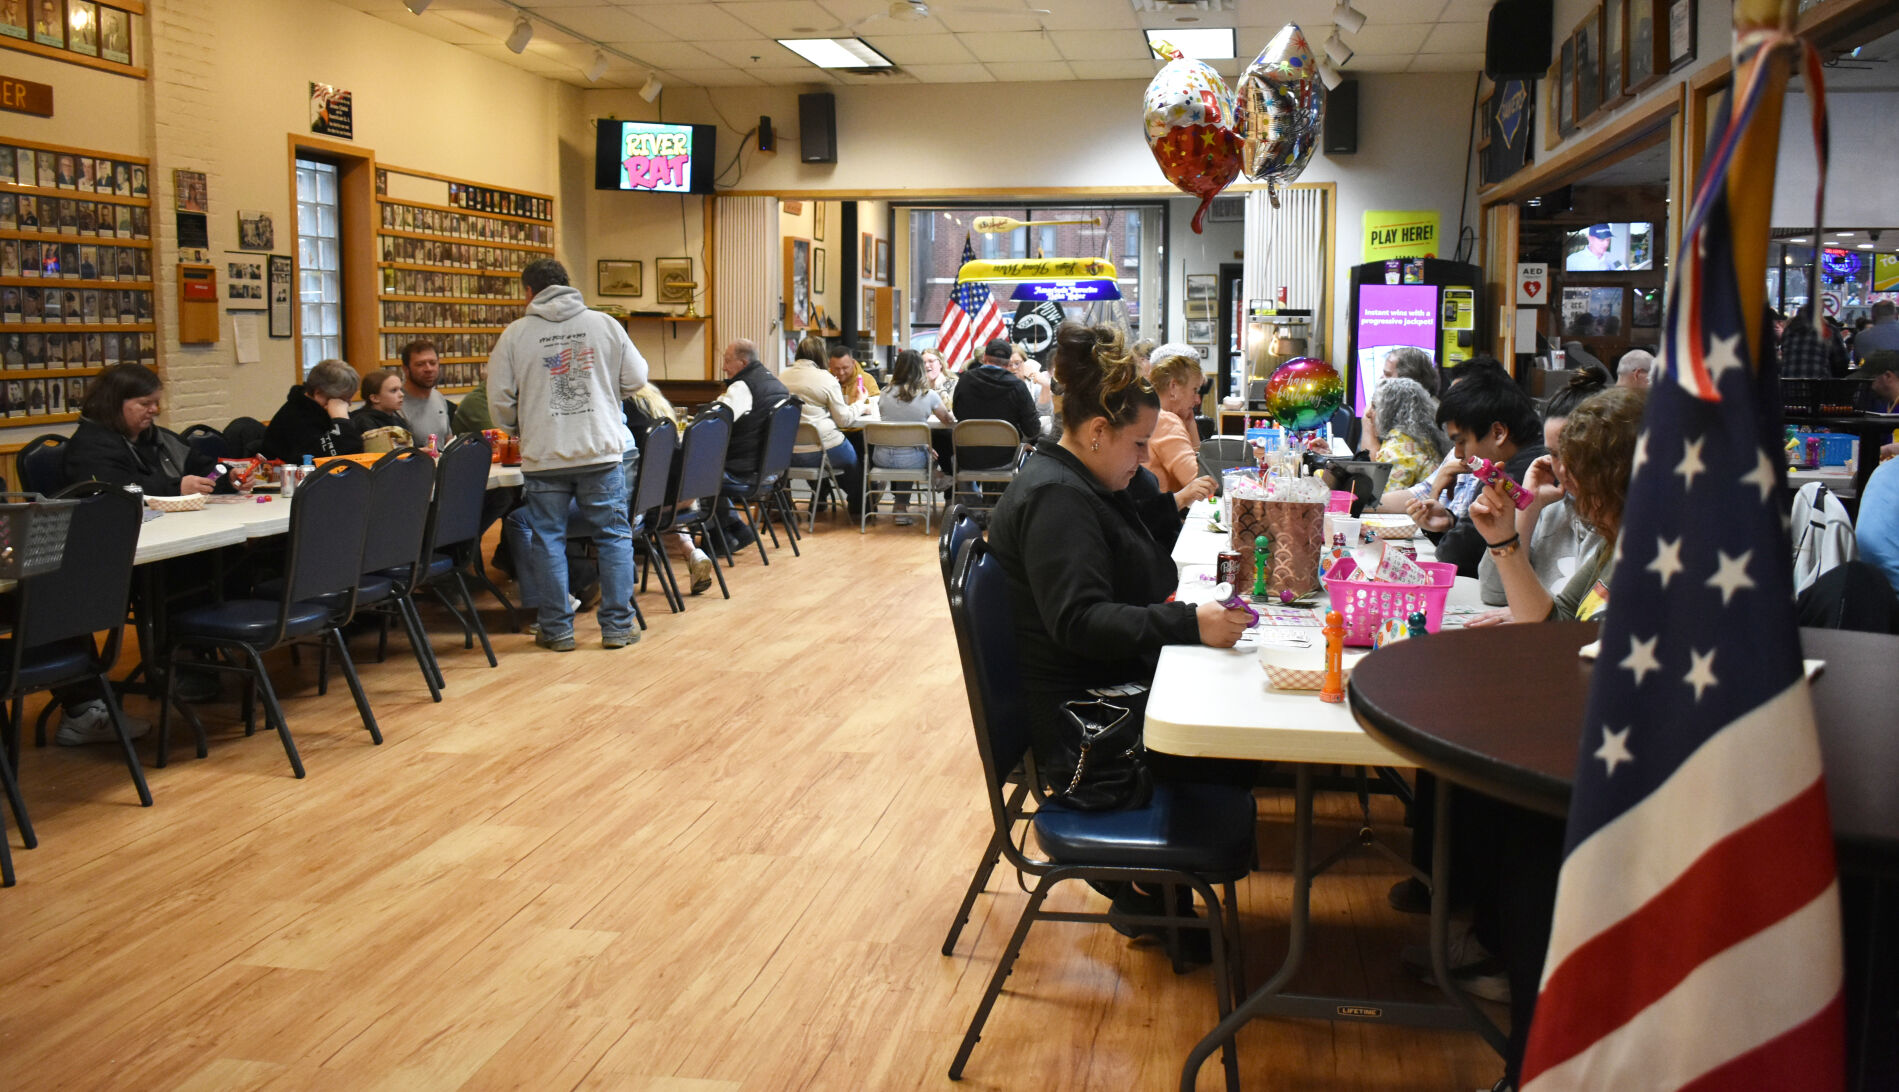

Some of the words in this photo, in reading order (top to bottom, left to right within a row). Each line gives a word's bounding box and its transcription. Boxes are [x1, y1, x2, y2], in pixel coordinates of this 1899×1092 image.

[0, 80, 27, 108] ER
[626, 132, 688, 156] RIVER
[622, 154, 689, 189] RAT
[1371, 229, 1398, 246] PLAY
[1402, 225, 1434, 242] HERE!
[1361, 318, 1403, 326] progressive
[1403, 318, 1434, 327] jackpot!
[1408, 309, 1425, 317] with
[1284, 371, 1320, 392] happy
[1275, 385, 1325, 408] birthday
[1342, 1007, 1377, 1015] LIFETIME
